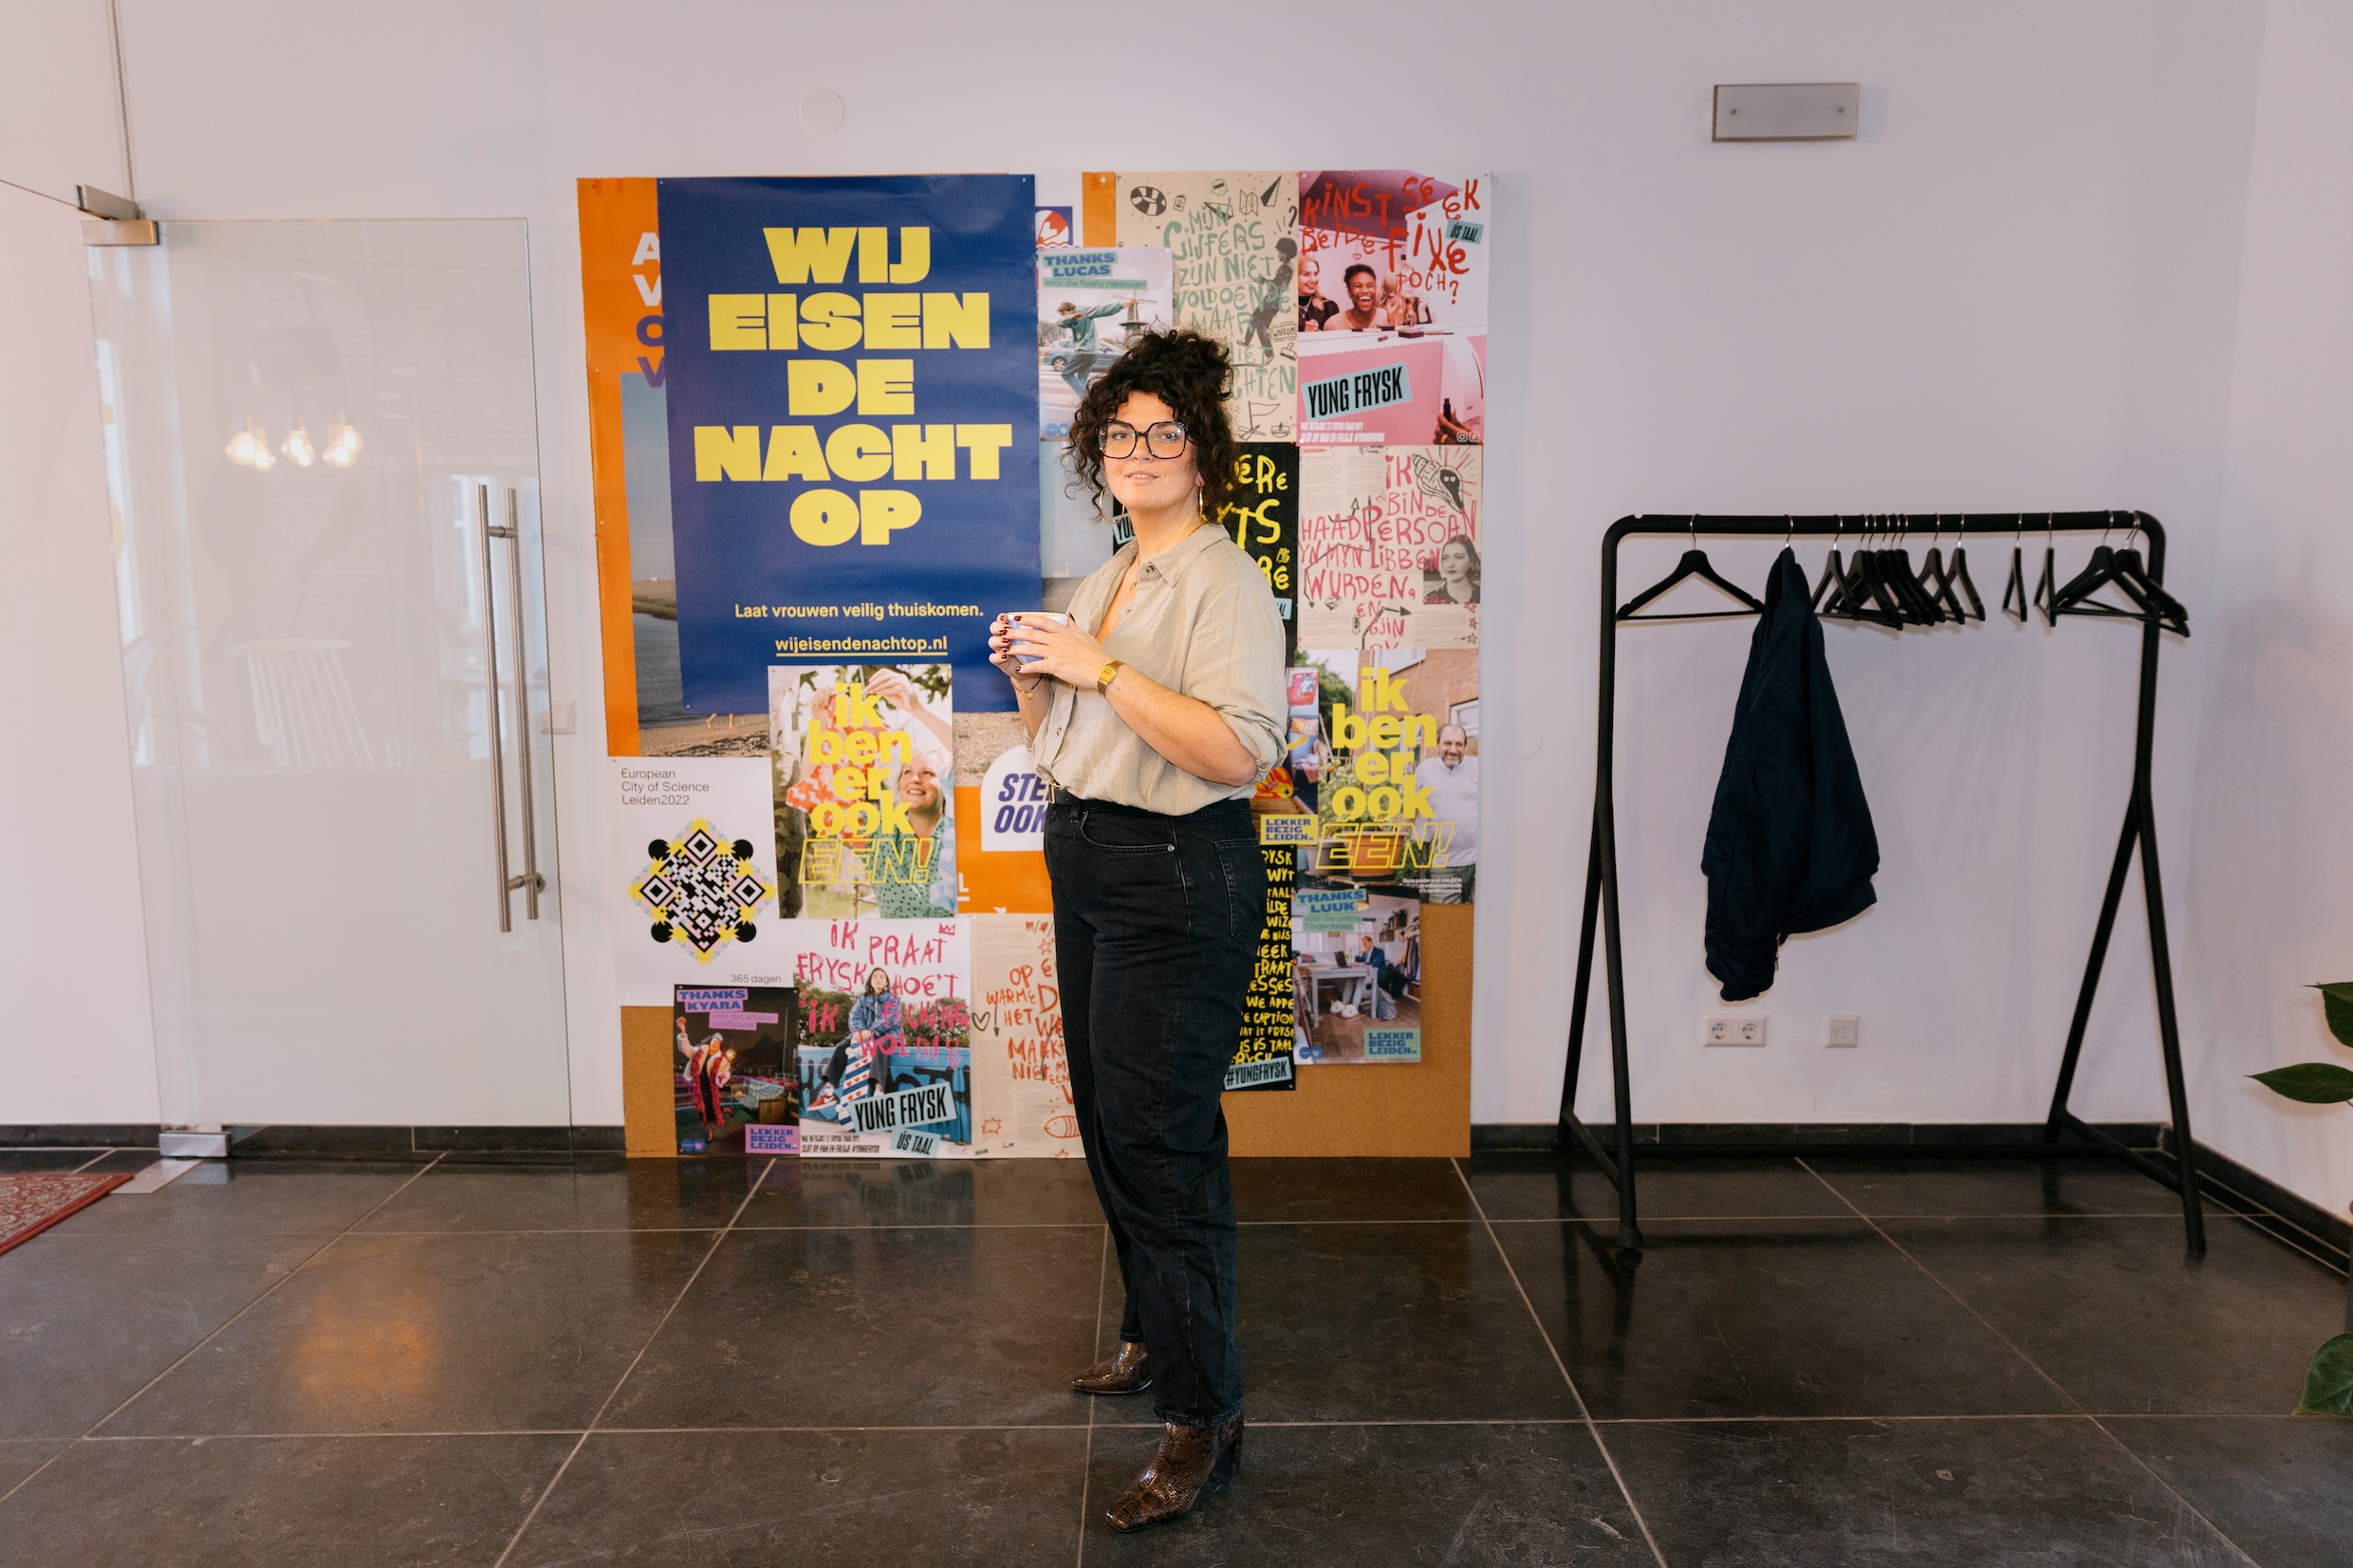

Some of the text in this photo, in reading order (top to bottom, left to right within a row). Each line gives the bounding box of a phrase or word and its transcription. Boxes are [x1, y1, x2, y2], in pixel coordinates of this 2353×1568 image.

[1188, 196, 1232, 234] MIJN
[1163, 220, 1265, 261] CIJFERS
[1462, 225, 1478, 242] TAAL
[763, 227, 931, 284] WIJ
[1044, 252, 1115, 266] THANKS
[1053, 265, 1110, 277] LUCAS
[1223, 252, 1275, 283] NIET
[1065, 279, 1078, 287] die
[708, 291, 991, 351] EISEN
[787, 359, 915, 415] DE
[1308, 366, 1402, 418] YUNG FRYSK
[694, 423, 1012, 481] NACHT
[1385, 454, 1412, 489] IK
[789, 489, 922, 546] OP
[1387, 489, 1447, 518] BIN DE
[735, 601, 984, 620] Laat vrouwen veilig thuiskomen.
[775, 636, 948, 655] wijeisendenachtop.nl
[1361, 667, 1410, 712] ik
[835, 683, 884, 728] ik
[1331, 703, 1437, 749] ben
[808, 719, 913, 765] ben
[621, 767, 676, 780] European
[1354, 750, 1415, 784] er
[621, 782, 710, 794] City of Science
[832, 766, 891, 800] er
[998, 773, 1049, 802] STE
[1331, 774, 1436, 821] ook
[621, 795, 690, 805] Leiden2022
[810, 790, 915, 838] ook
[1297, 890, 1364, 903] THANKS
[1310, 902, 1356, 913] LUUK
[830, 918, 947, 968] IK PRAAT
[731, 974, 781, 986] 365 dagen
[795, 952, 867, 992] FRYSK
[1010, 964, 1033, 988] OP
[679, 989, 746, 1000] THANKS
[687, 1001, 741, 1011] KYARA
[986, 988, 1036, 1005] WARME
[808, 1000, 839, 1034] IK
[1004, 1008, 1034, 1026] HET
[1227, 1061, 1288, 1087] #YUNGFRYSK
[855, 1086, 948, 1133] YUNG FRYSK
[909, 1134, 934, 1155] TAAL
